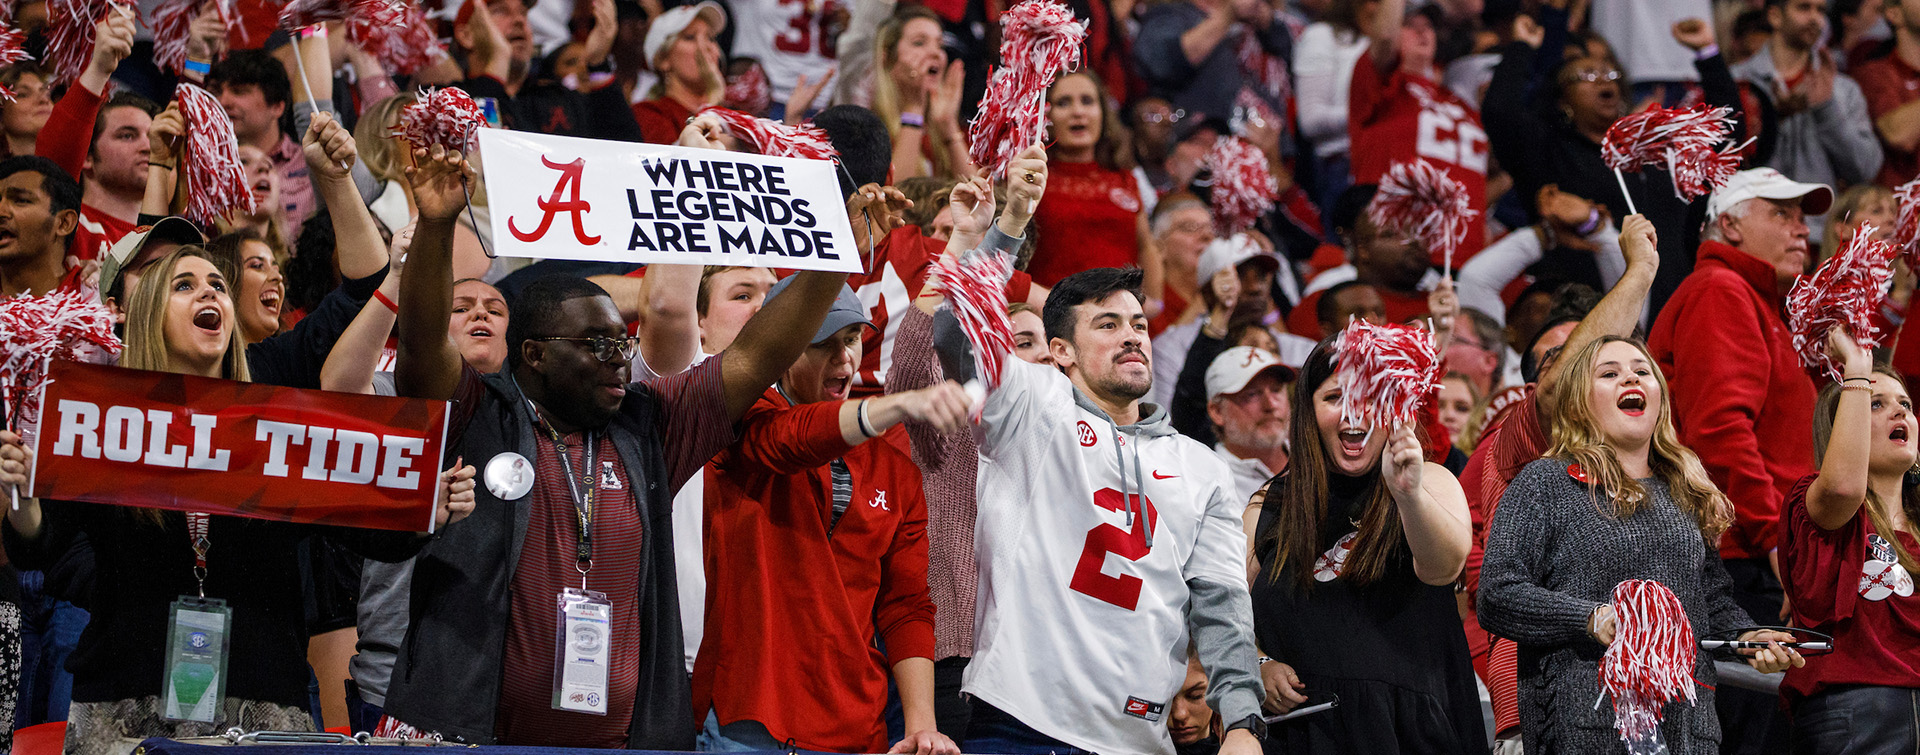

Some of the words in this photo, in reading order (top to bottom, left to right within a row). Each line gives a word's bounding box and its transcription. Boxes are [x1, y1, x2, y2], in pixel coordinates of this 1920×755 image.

[641, 157, 791, 196] WHERE
[508, 154, 602, 246] A
[626, 188, 817, 228] LEGENDS
[627, 222, 713, 254] ARE
[717, 224, 841, 261] MADE
[52, 398, 232, 474] ROLL
[255, 418, 426, 491] TIDE
[868, 488, 888, 511] A
[1069, 487, 1159, 612] 2
